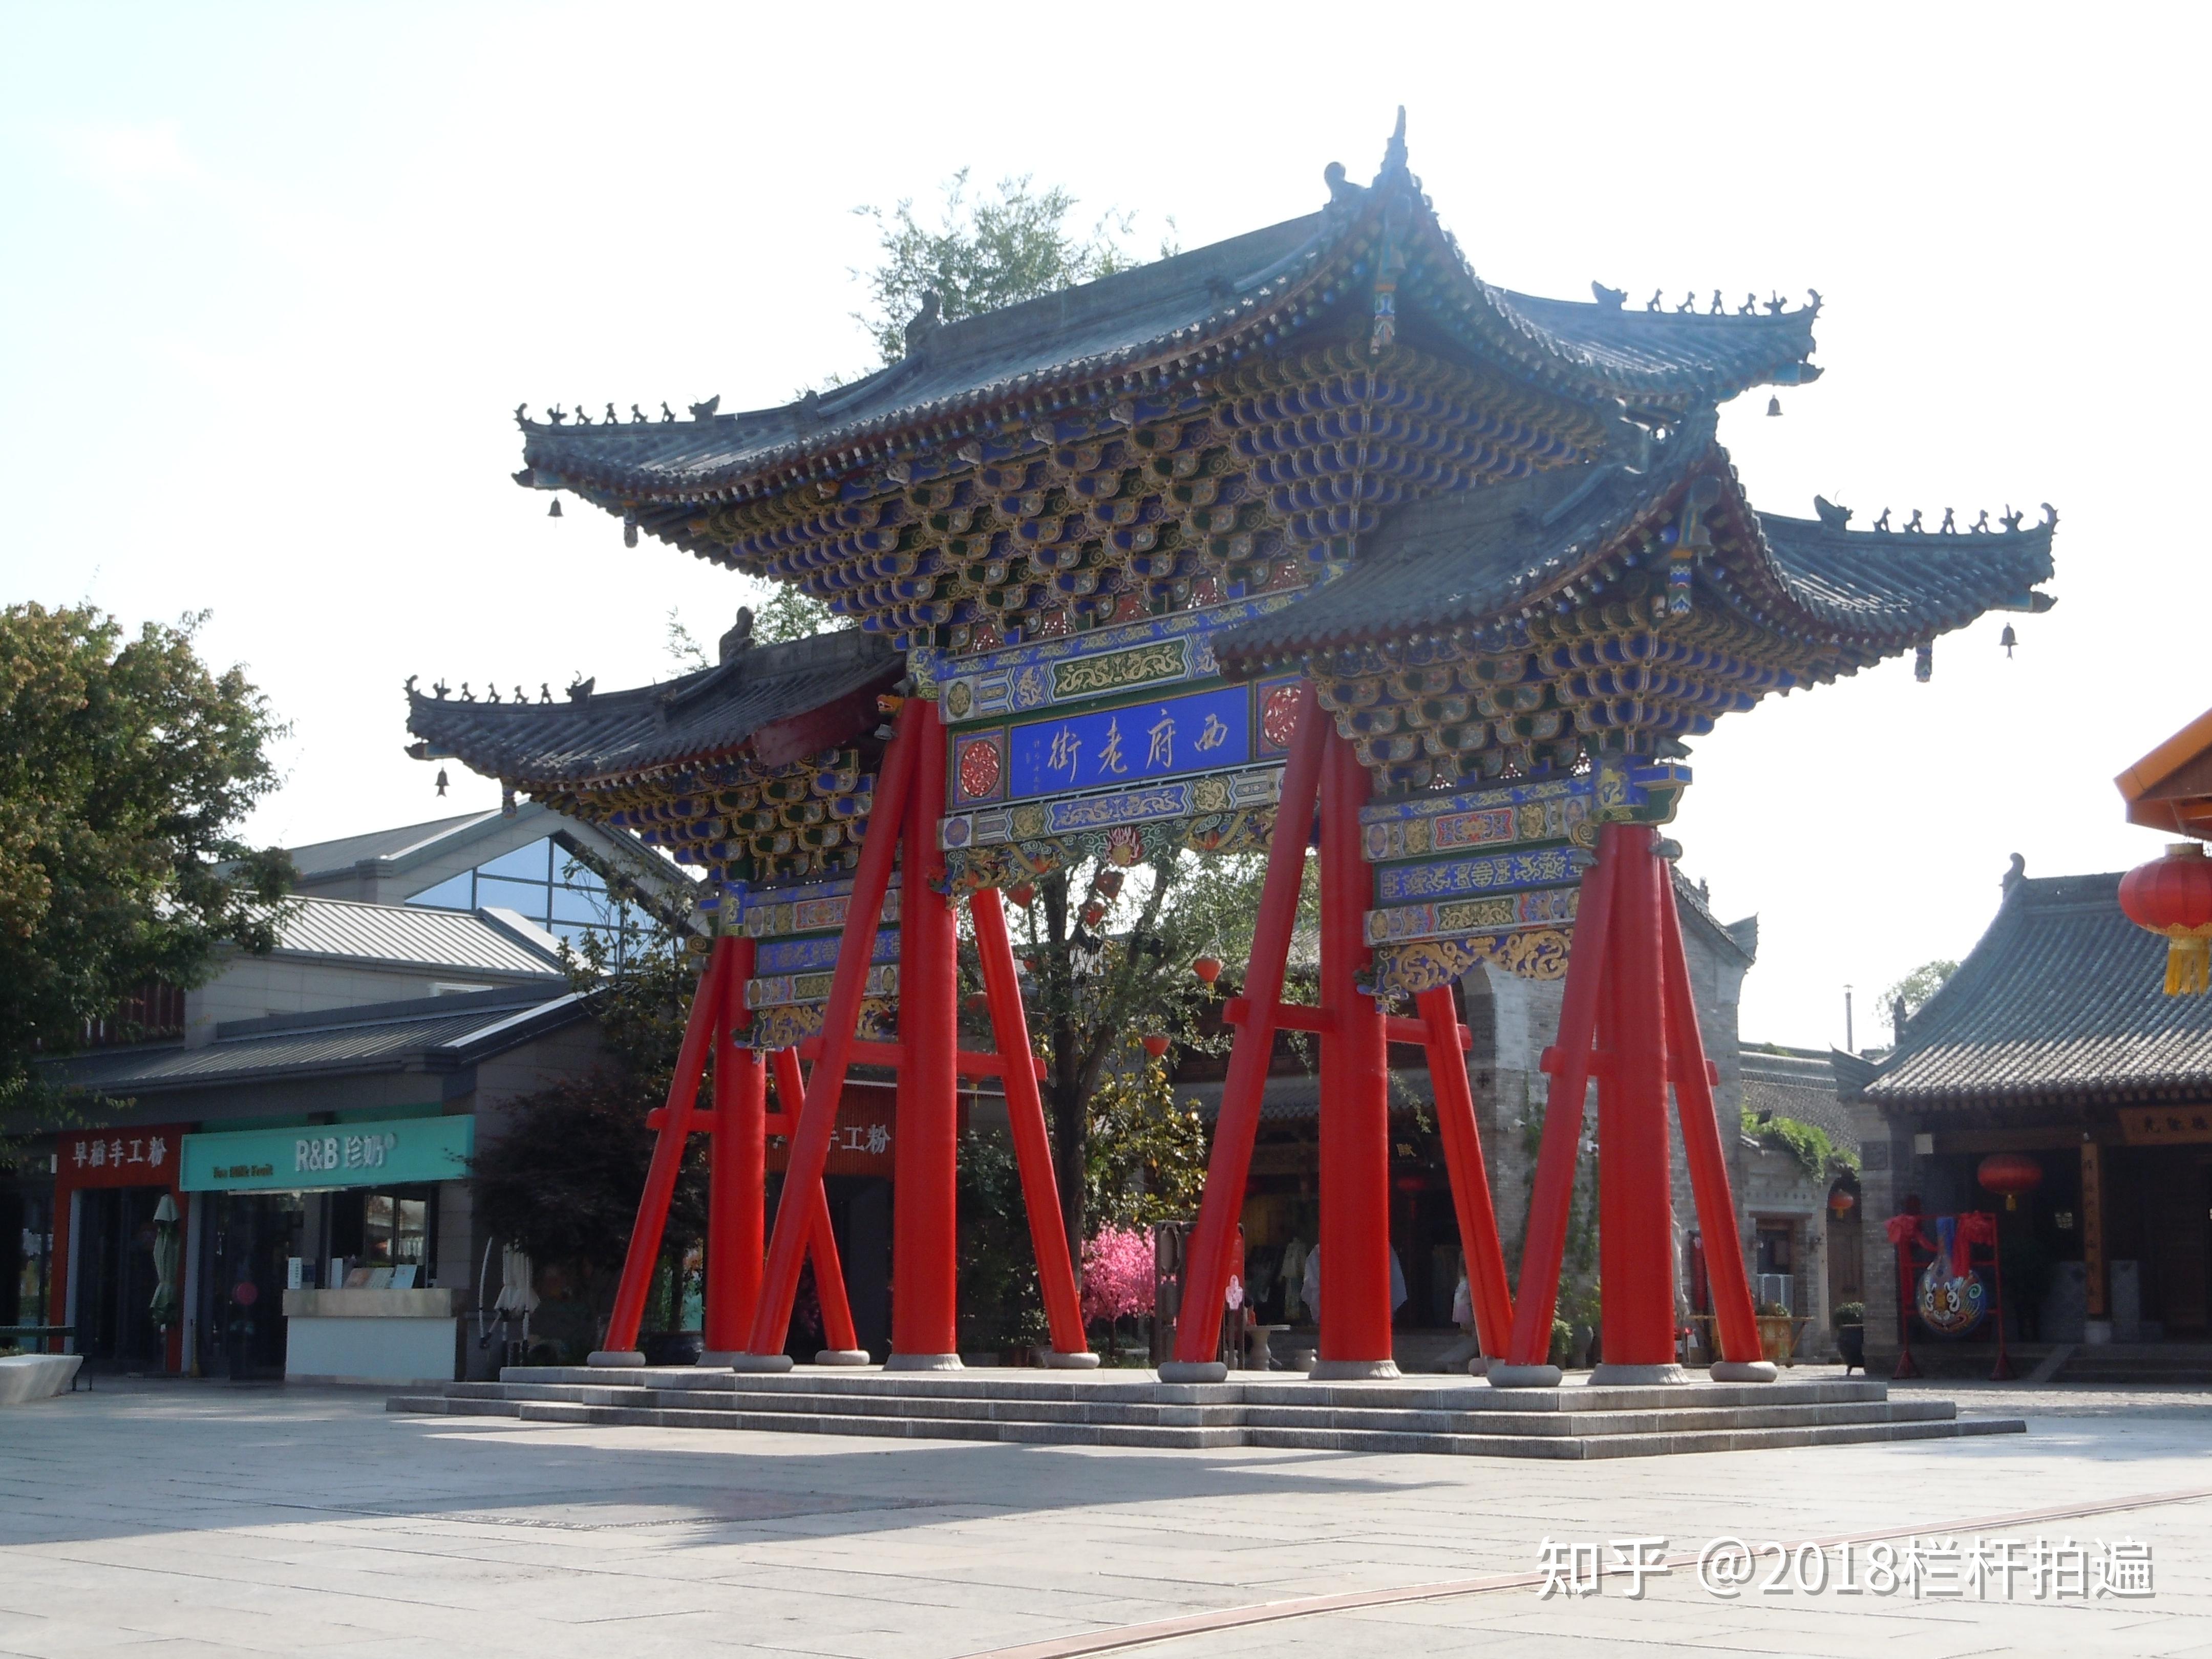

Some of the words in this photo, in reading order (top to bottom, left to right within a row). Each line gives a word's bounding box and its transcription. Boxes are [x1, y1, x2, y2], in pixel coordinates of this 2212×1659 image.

[1047, 708, 1228, 783] 西府老街
[72, 1136, 167, 1168] 早稻手工粉
[295, 1137, 338, 1172] R&B
[341, 1135, 383, 1169] 珍奶
